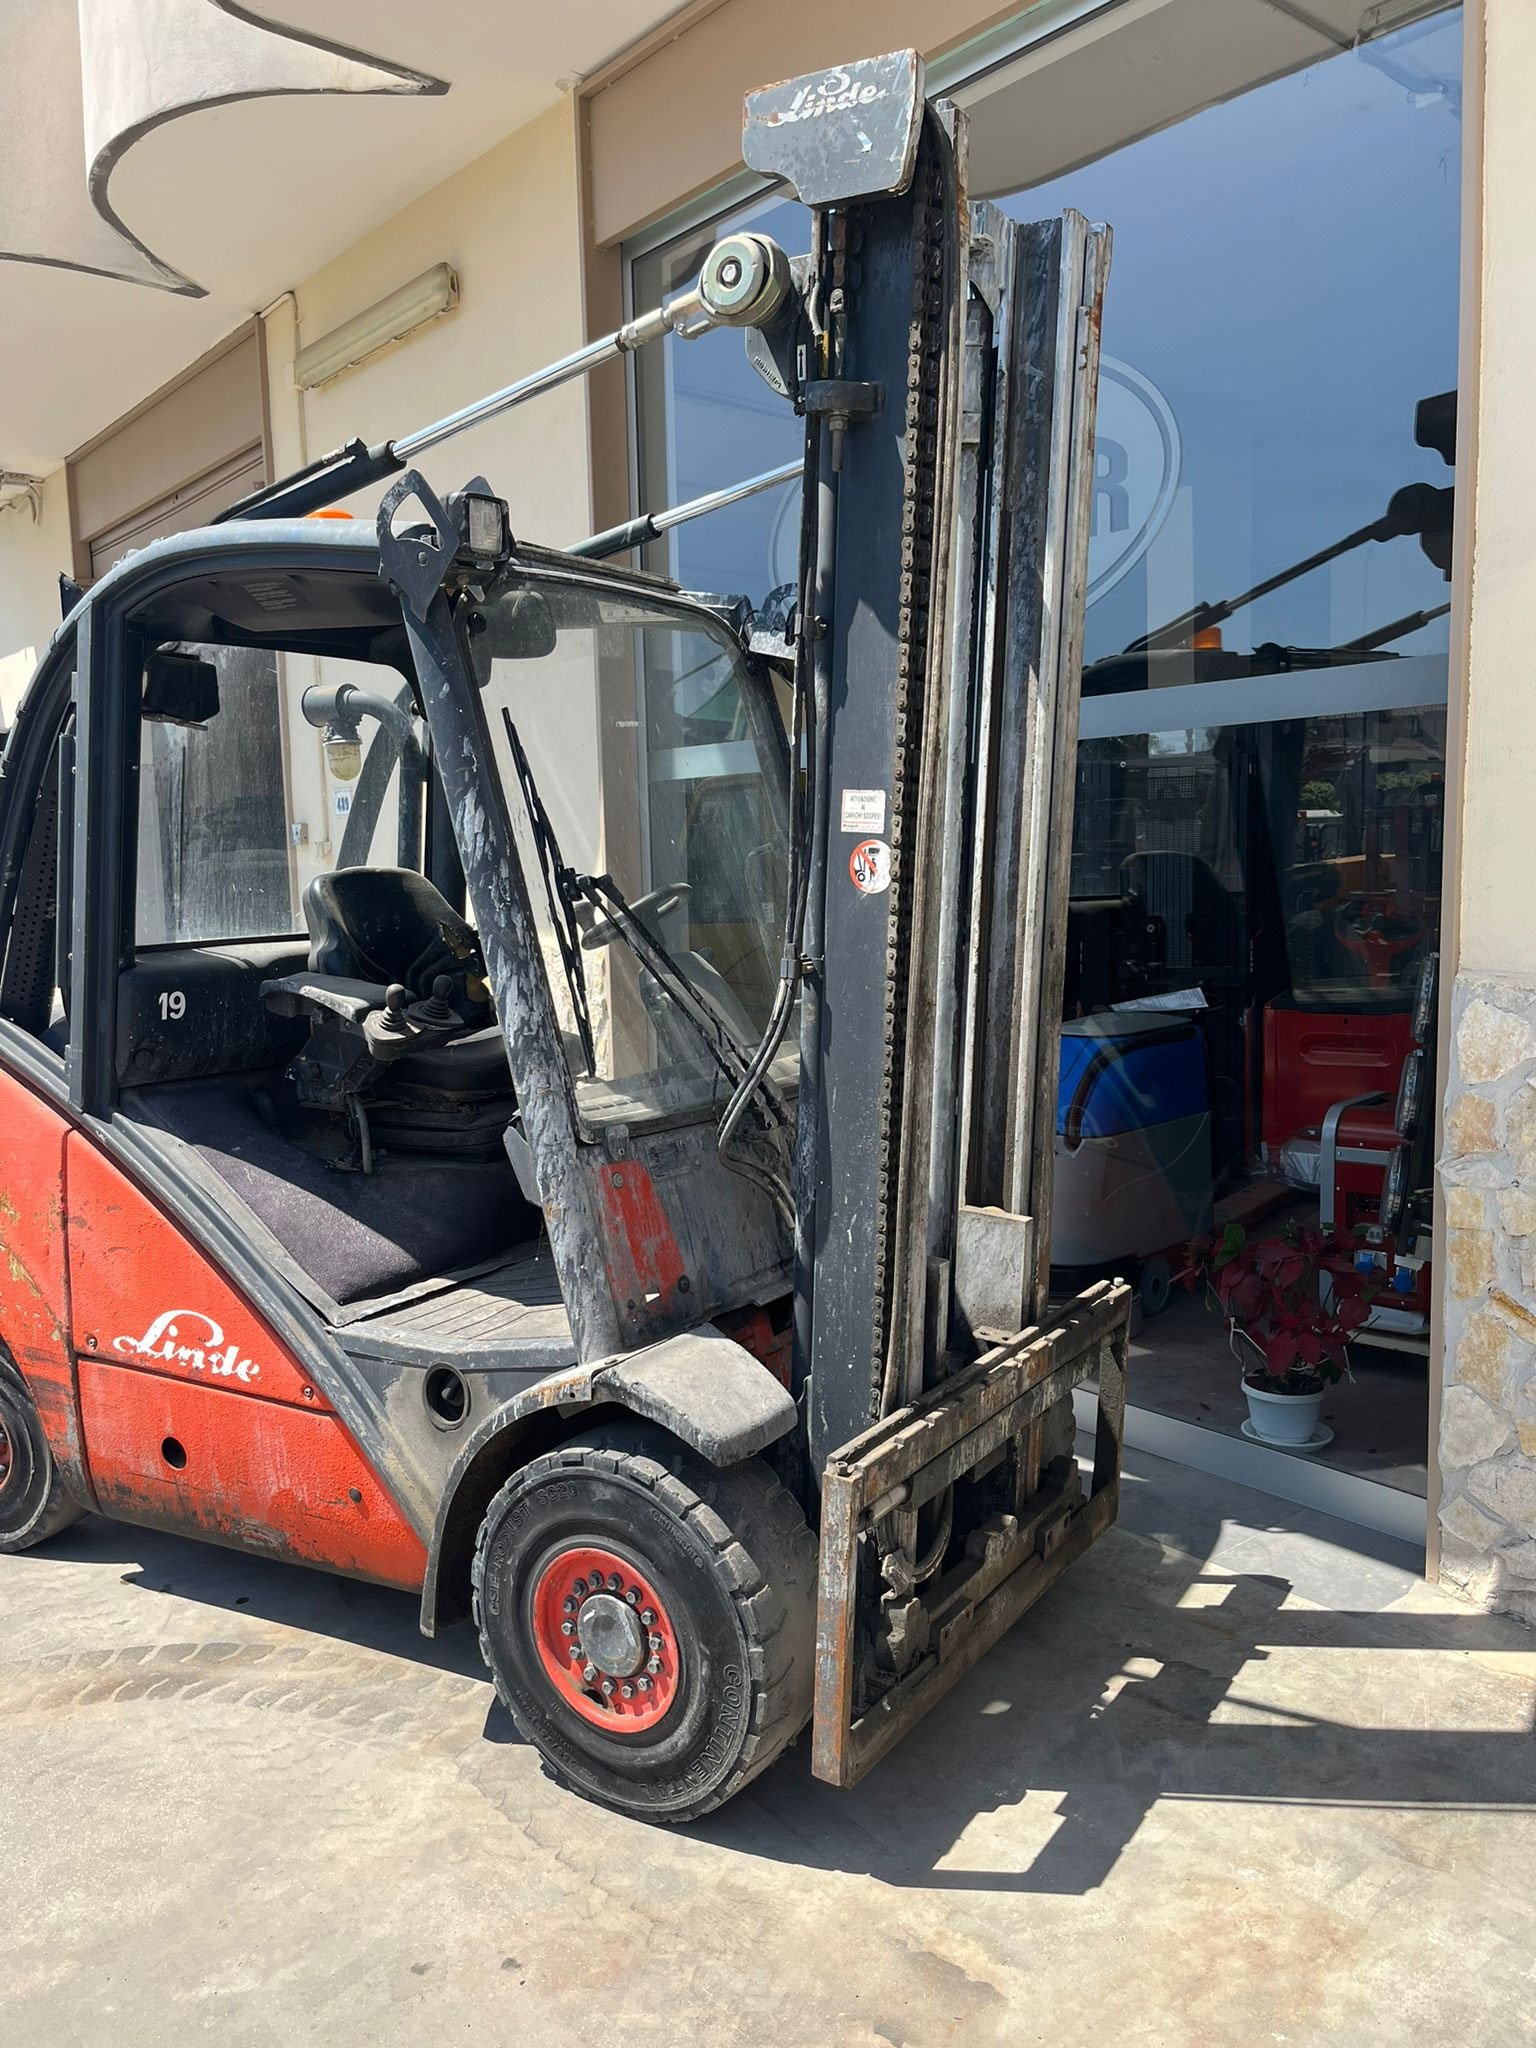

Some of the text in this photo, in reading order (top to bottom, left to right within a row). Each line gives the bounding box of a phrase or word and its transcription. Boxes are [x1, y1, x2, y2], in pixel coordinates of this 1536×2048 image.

[767, 70, 889, 127] Linde
[158, 991, 187, 1020] 19
[112, 1309, 260, 1383] Linde
[639, 1663, 742, 1801] CONTINENTAL
